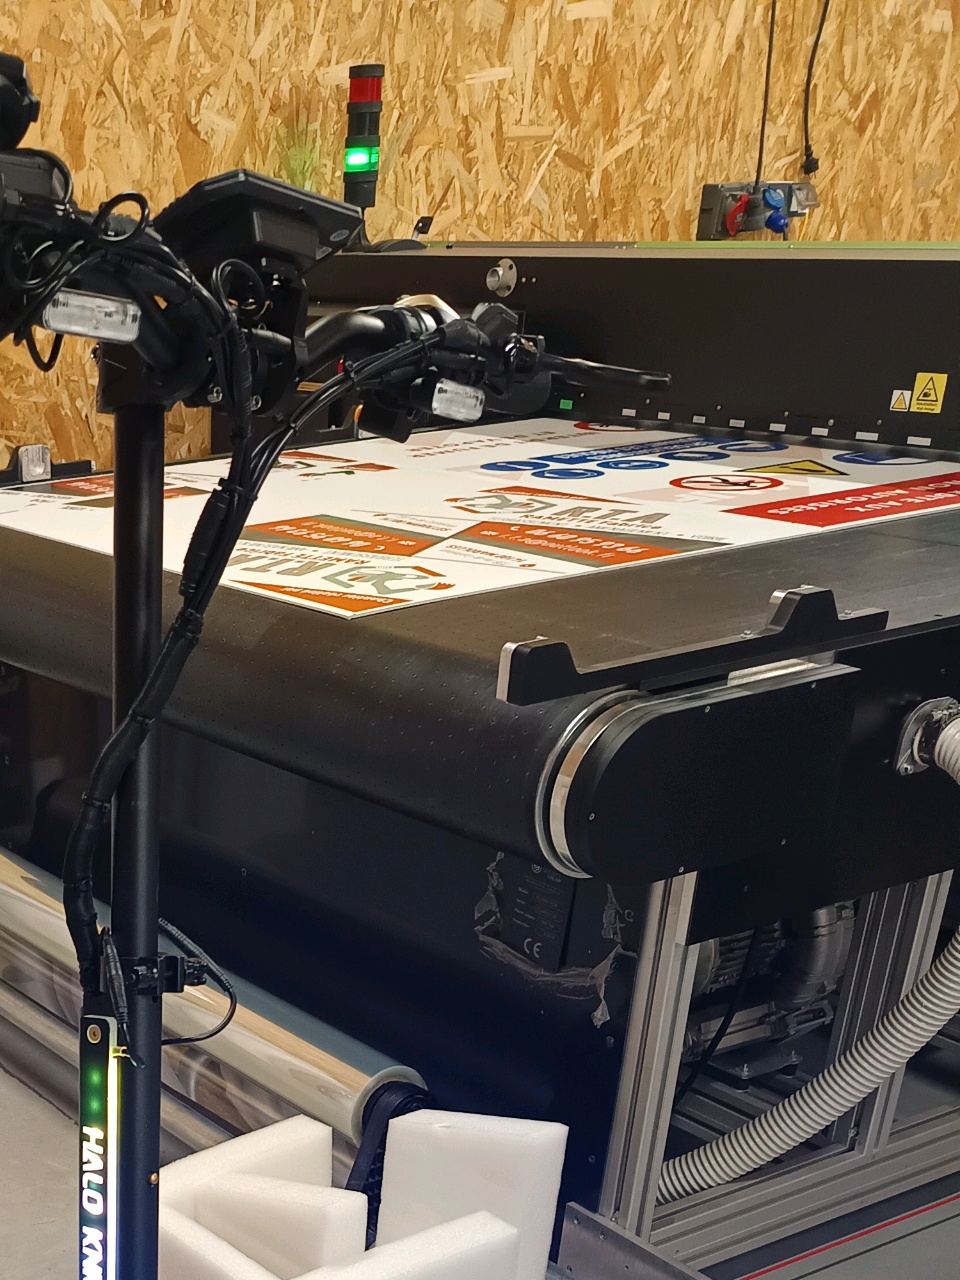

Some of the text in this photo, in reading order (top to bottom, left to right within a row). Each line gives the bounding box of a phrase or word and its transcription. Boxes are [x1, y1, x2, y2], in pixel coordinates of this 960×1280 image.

[844, 501, 902, 512] AUX
[523, 938, 542, 958] CE
[81, 1125, 104, 1217] HALO
